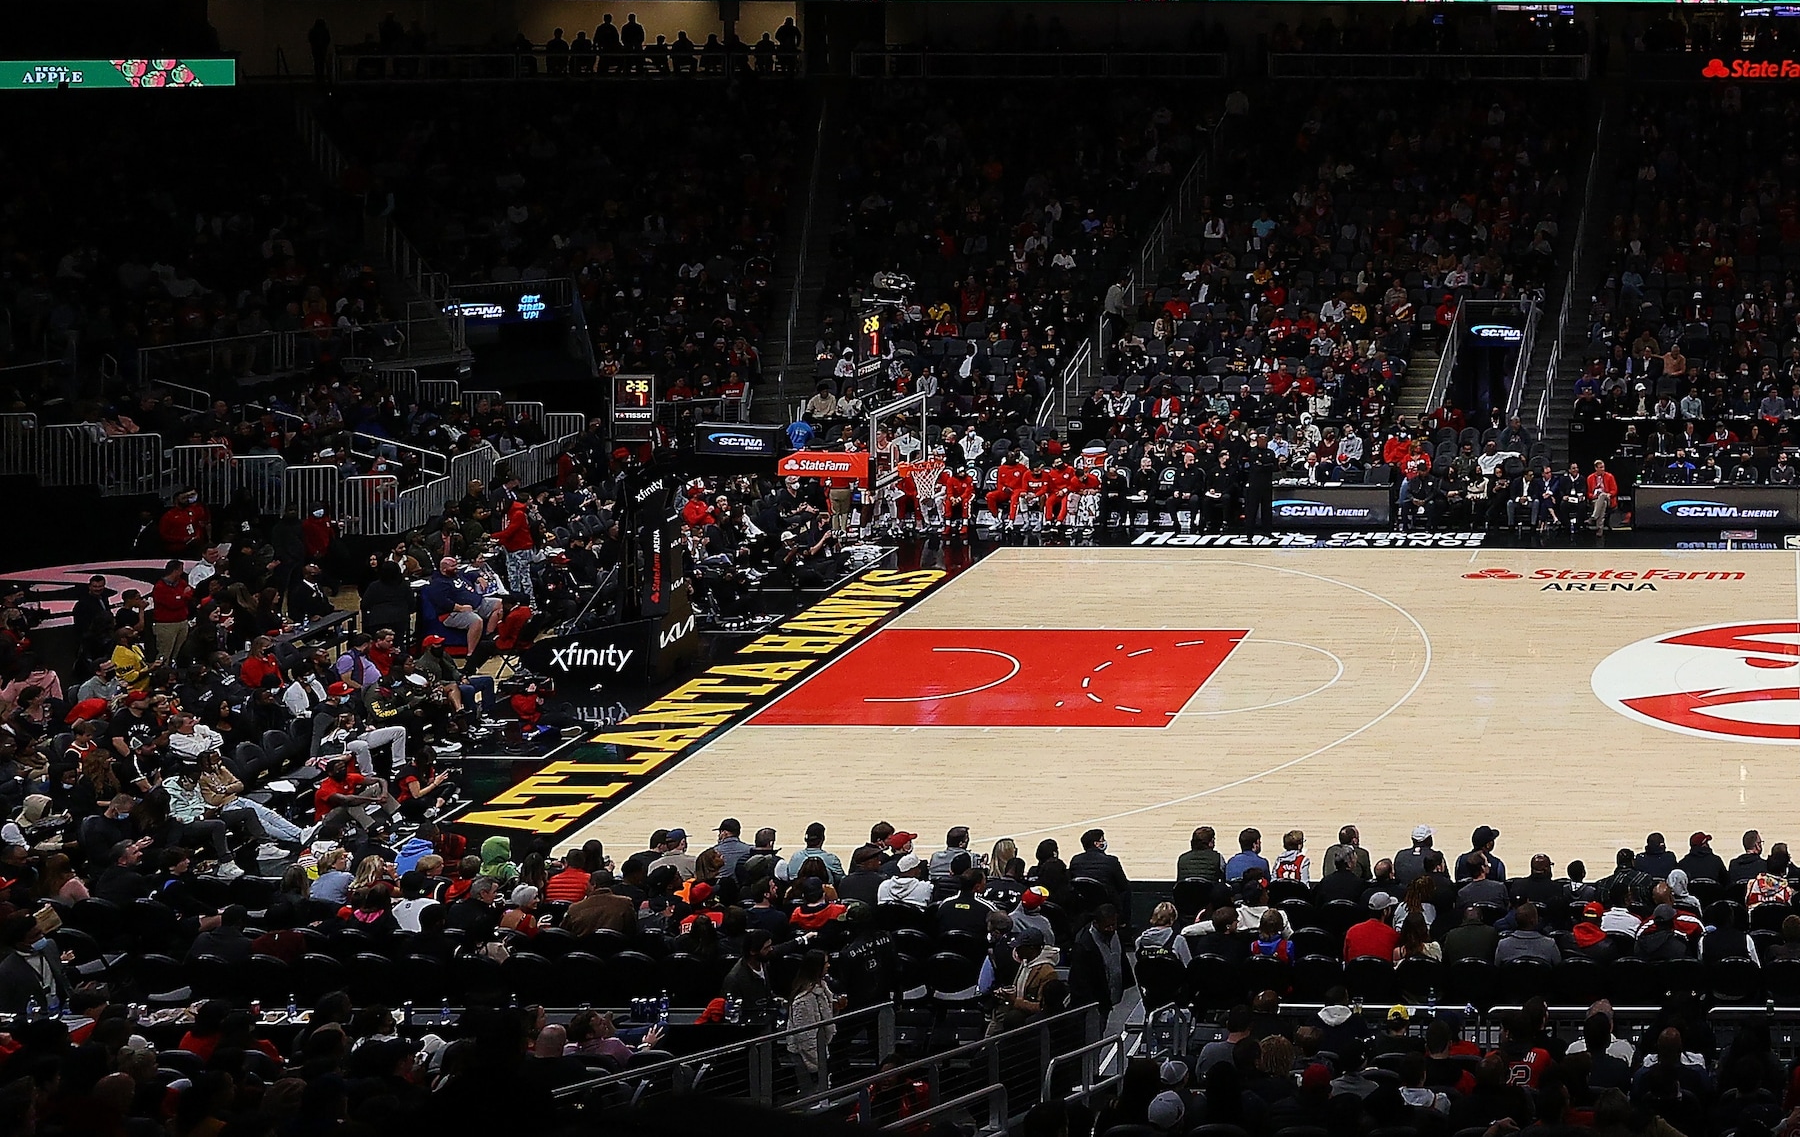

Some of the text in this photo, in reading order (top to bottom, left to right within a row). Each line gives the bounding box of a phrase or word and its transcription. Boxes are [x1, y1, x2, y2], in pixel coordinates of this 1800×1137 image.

[22, 71, 83, 83] APPLE
[626, 380, 649, 393] 2:36
[718, 437, 763, 447] SCANA
[635, 478, 664, 503] xfinity
[1280, 505, 1370, 517] SCANA ENERGY
[1676, 506, 1779, 518] SCANA ENERGY
[1331, 531, 1486, 540] CHEROKEE
[1529, 569, 1747, 582] State Farm
[1540, 582, 1658, 592] ARENA
[736, 569, 948, 655] HAWKS
[550, 642, 633, 672] xfinity
[455, 659, 818, 834] ATLANTA
